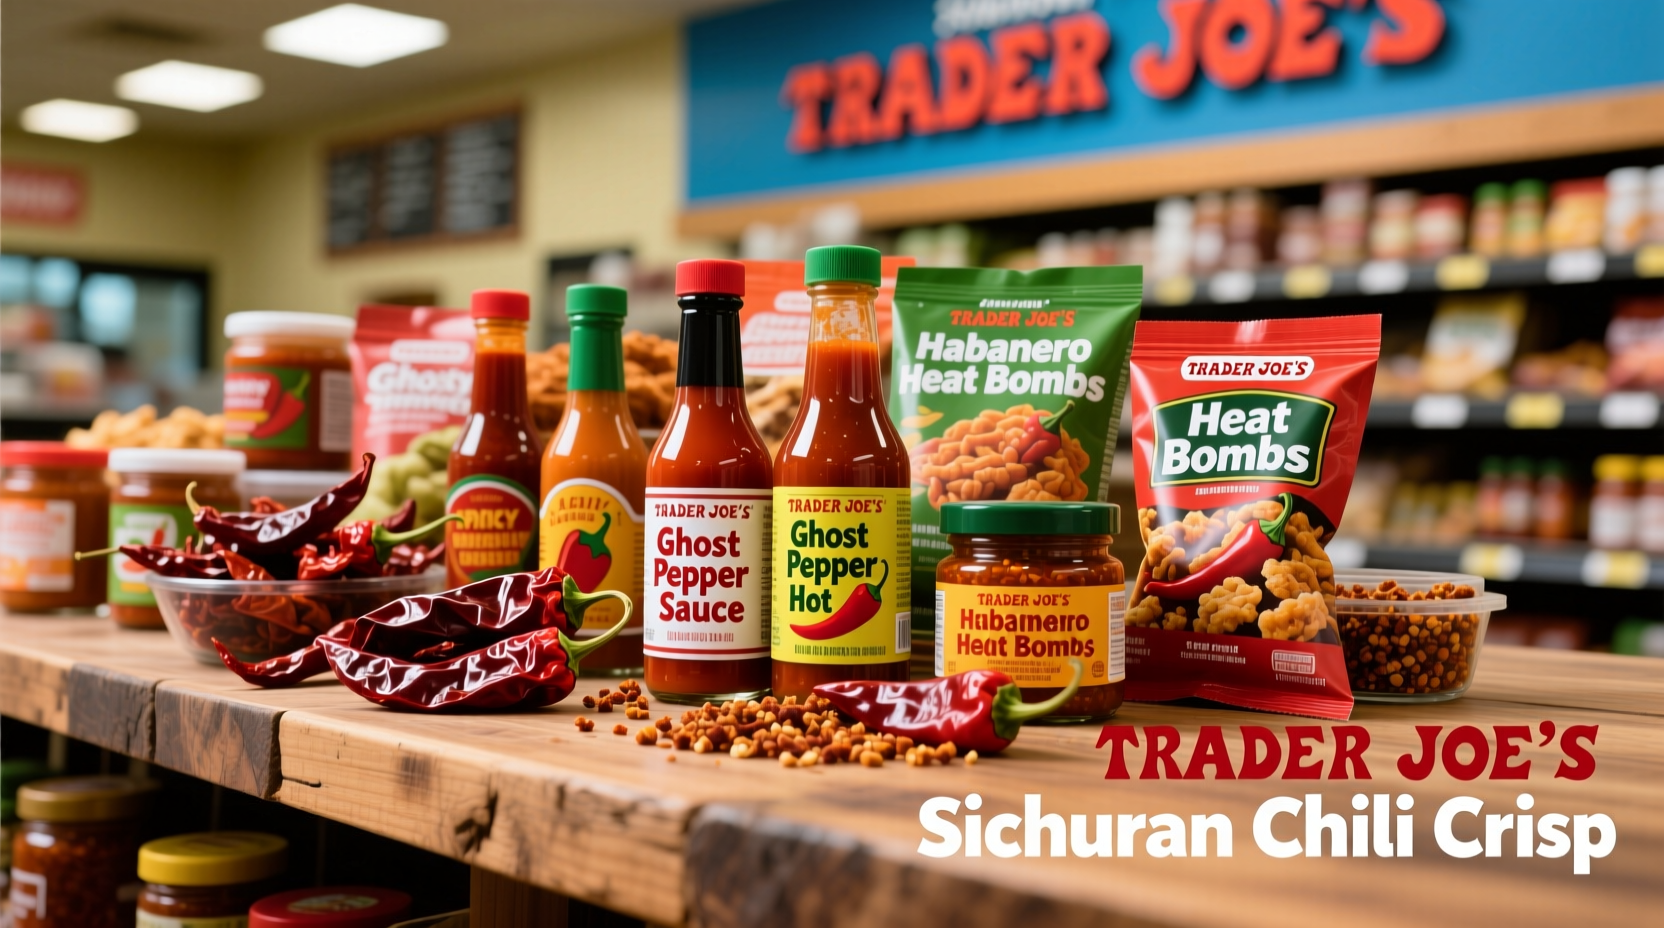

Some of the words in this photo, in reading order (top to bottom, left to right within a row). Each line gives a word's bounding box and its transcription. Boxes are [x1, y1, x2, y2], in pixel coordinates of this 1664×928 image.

[782, 11, 1112, 154] TRADER
[1130, 0, 1446, 100] JOES
[950, 310, 1021, 327] TRADER
[1024, 310, 1075, 327] JOE'S
[915, 331, 1092, 363] Habanero
[899, 363, 979, 395] Heat
[983, 363, 1106, 402] Bombs
[1187, 362, 1255, 376] TRADER
[1258, 360, 1309, 376] JOE'S
[1187, 401, 1292, 437] Heat
[1161, 434, 1310, 476] Bombs
[655, 504, 705, 518] TRADER
[709, 504, 750, 519] JOE'S
[788, 499, 841, 513] TRADER
[844, 499, 884, 513] JOE'S
[657, 527, 740, 557] Ghost
[790, 520, 868, 549] Ghost
[654, 558, 749, 596] Pepper
[787, 550, 878, 585] Pepper
[659, 592, 745, 623] Sauce
[789, 585, 832, 613] Hot
[977, 593, 1029, 606] TRADER
[1033, 594, 1070, 606] JOE'S
[1015, 635, 1094, 657] Bombs
